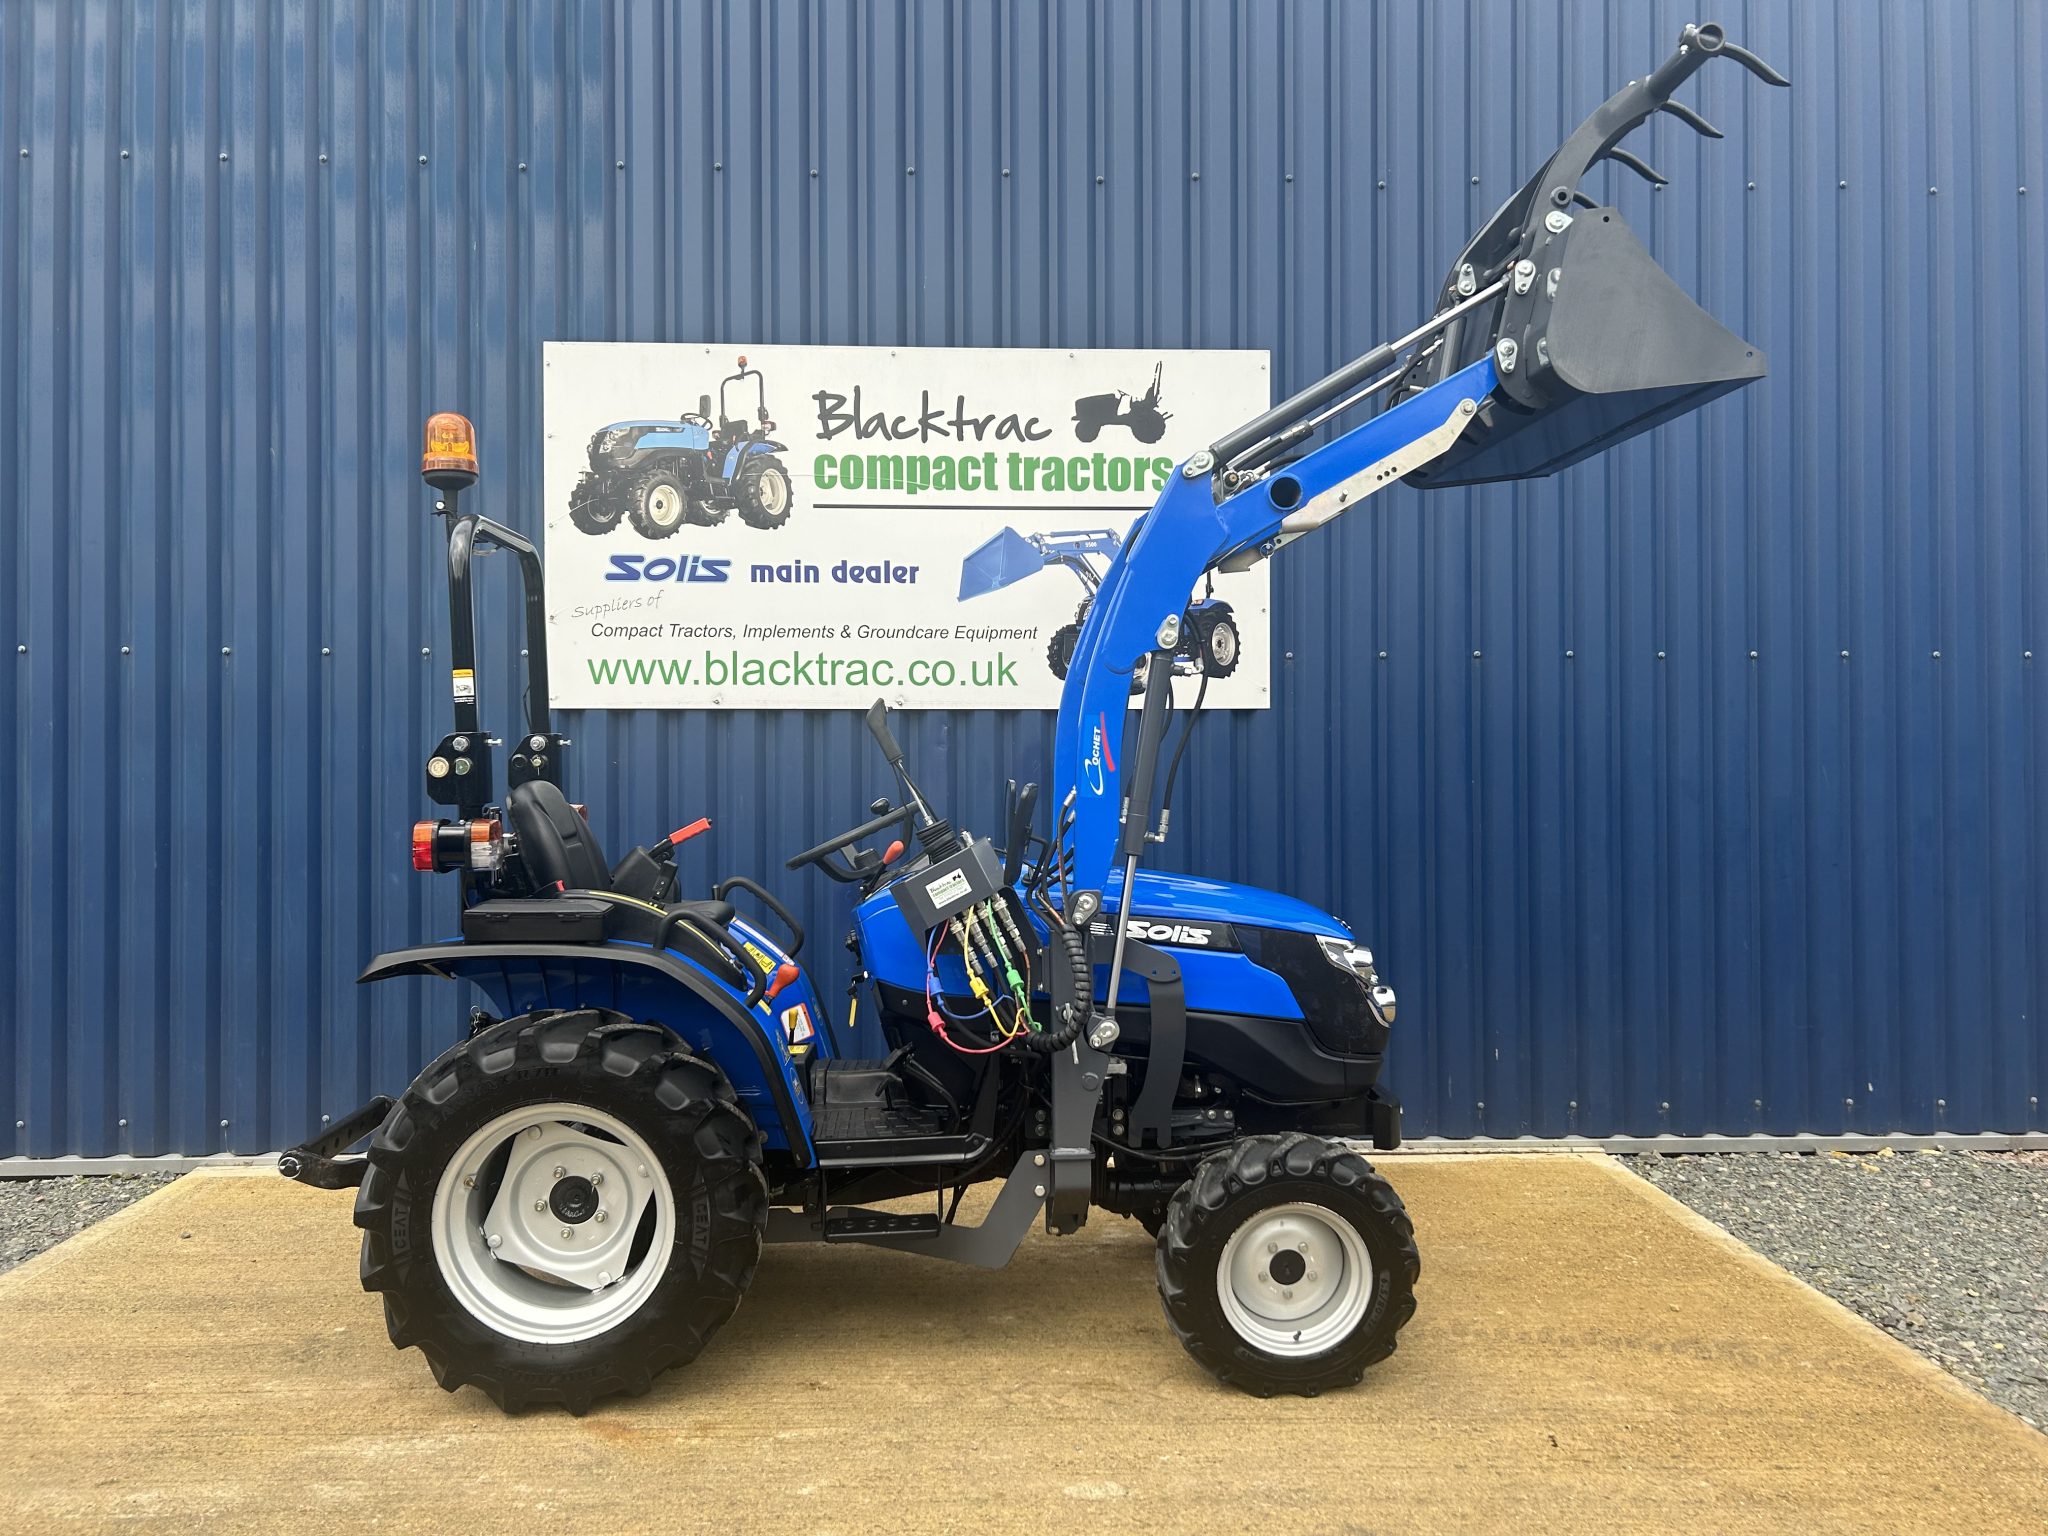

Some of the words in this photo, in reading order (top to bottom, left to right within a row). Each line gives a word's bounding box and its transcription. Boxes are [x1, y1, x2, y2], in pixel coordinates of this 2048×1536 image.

[812, 385, 1052, 443] Blacktrac
[814, 452, 998, 494] compact
[1007, 452, 1174, 492] tractors
[604, 555, 732, 583] Solis
[750, 559, 819, 583] main
[831, 560, 920, 584] dealer
[571, 597, 642, 620] Suppliers
[647, 589, 665, 607] of
[591, 623, 663, 641] Compact
[670, 624, 736, 641] Tractors,
[743, 625, 835, 642] Implements
[840, 625, 852, 639] &
[857, 625, 949, 640] Groundcare
[954, 626, 1038, 642] Equipment
[587, 650, 1019, 687] www.blacktrac.co.uk
[1126, 920, 1212, 945] Solis
[394, 1207, 406, 1249] CEAT
[695, 1203, 708, 1245] CEAT
